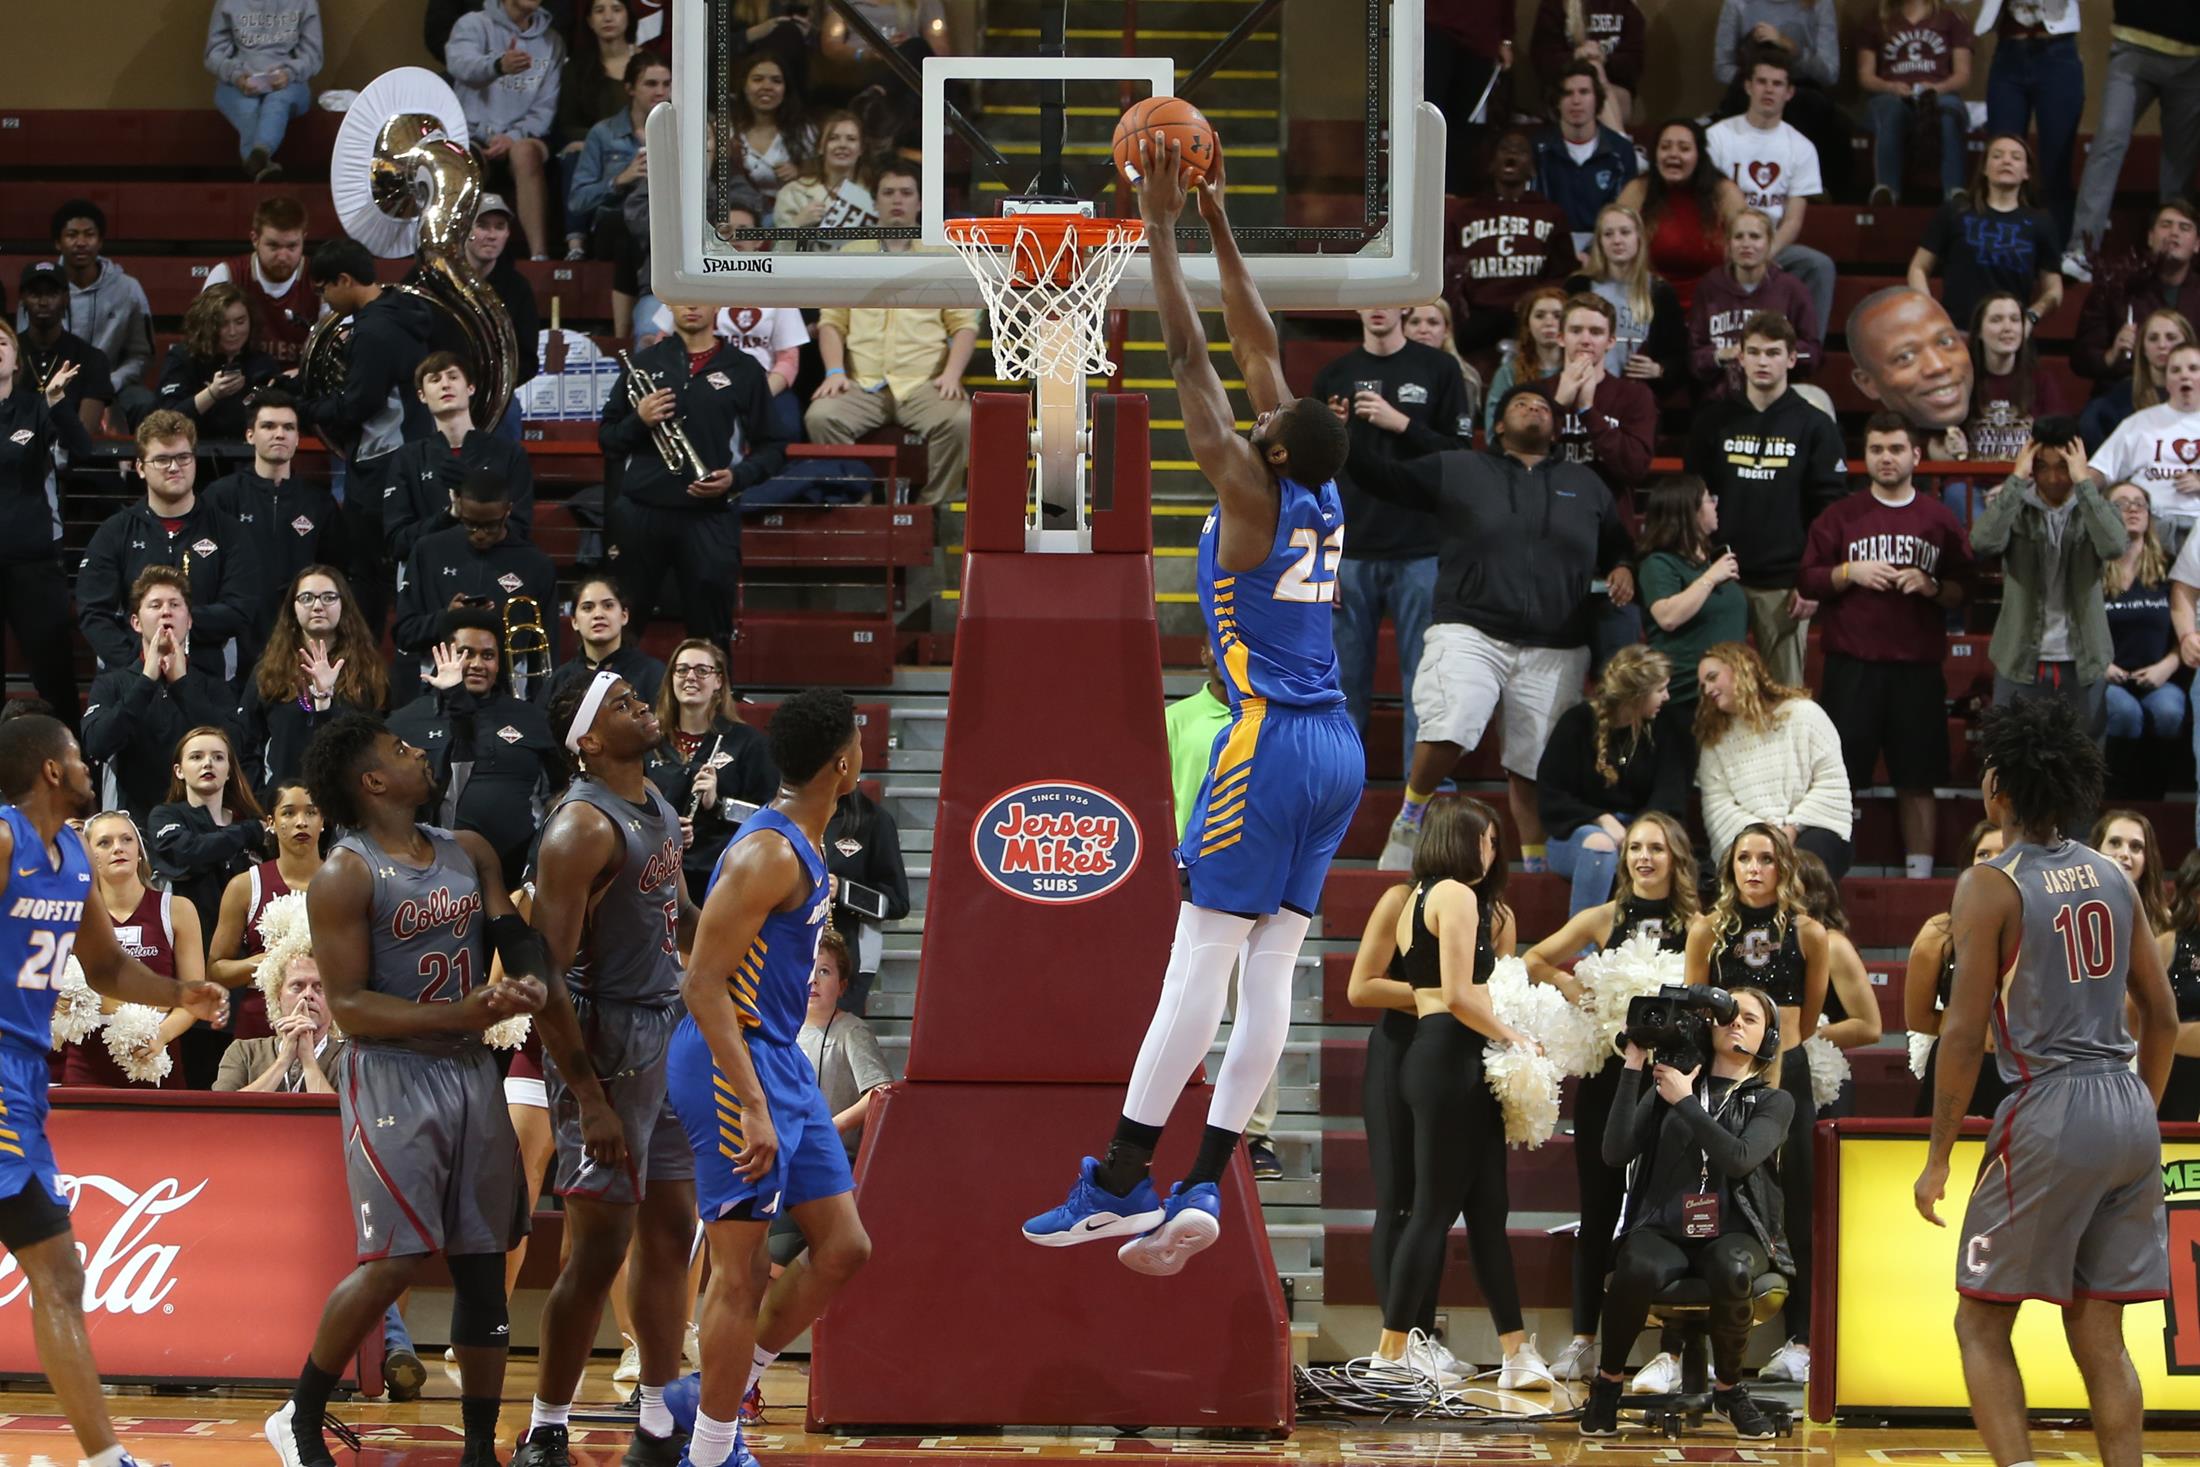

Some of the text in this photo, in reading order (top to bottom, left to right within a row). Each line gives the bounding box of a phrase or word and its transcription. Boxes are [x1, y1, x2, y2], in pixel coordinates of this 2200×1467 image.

[703, 257, 773, 274] SPALDING
[1737, 466, 1777, 480] HOCKEY
[1848, 533, 1942, 574] CHARLESTON
[1031, 793, 1089, 806] SINCE 1956
[995, 803, 1119, 850] Jersey
[1001, 838, 1116, 876] Mike's
[1033, 878, 1078, 892] SUBS
[2041, 863, 2101, 895] JASPER
[392, 885, 482, 940] College
[2053, 899, 2115, 984] 10
[416, 947, 473, 1005] 21
[1966, 1234, 1992, 1275] C
